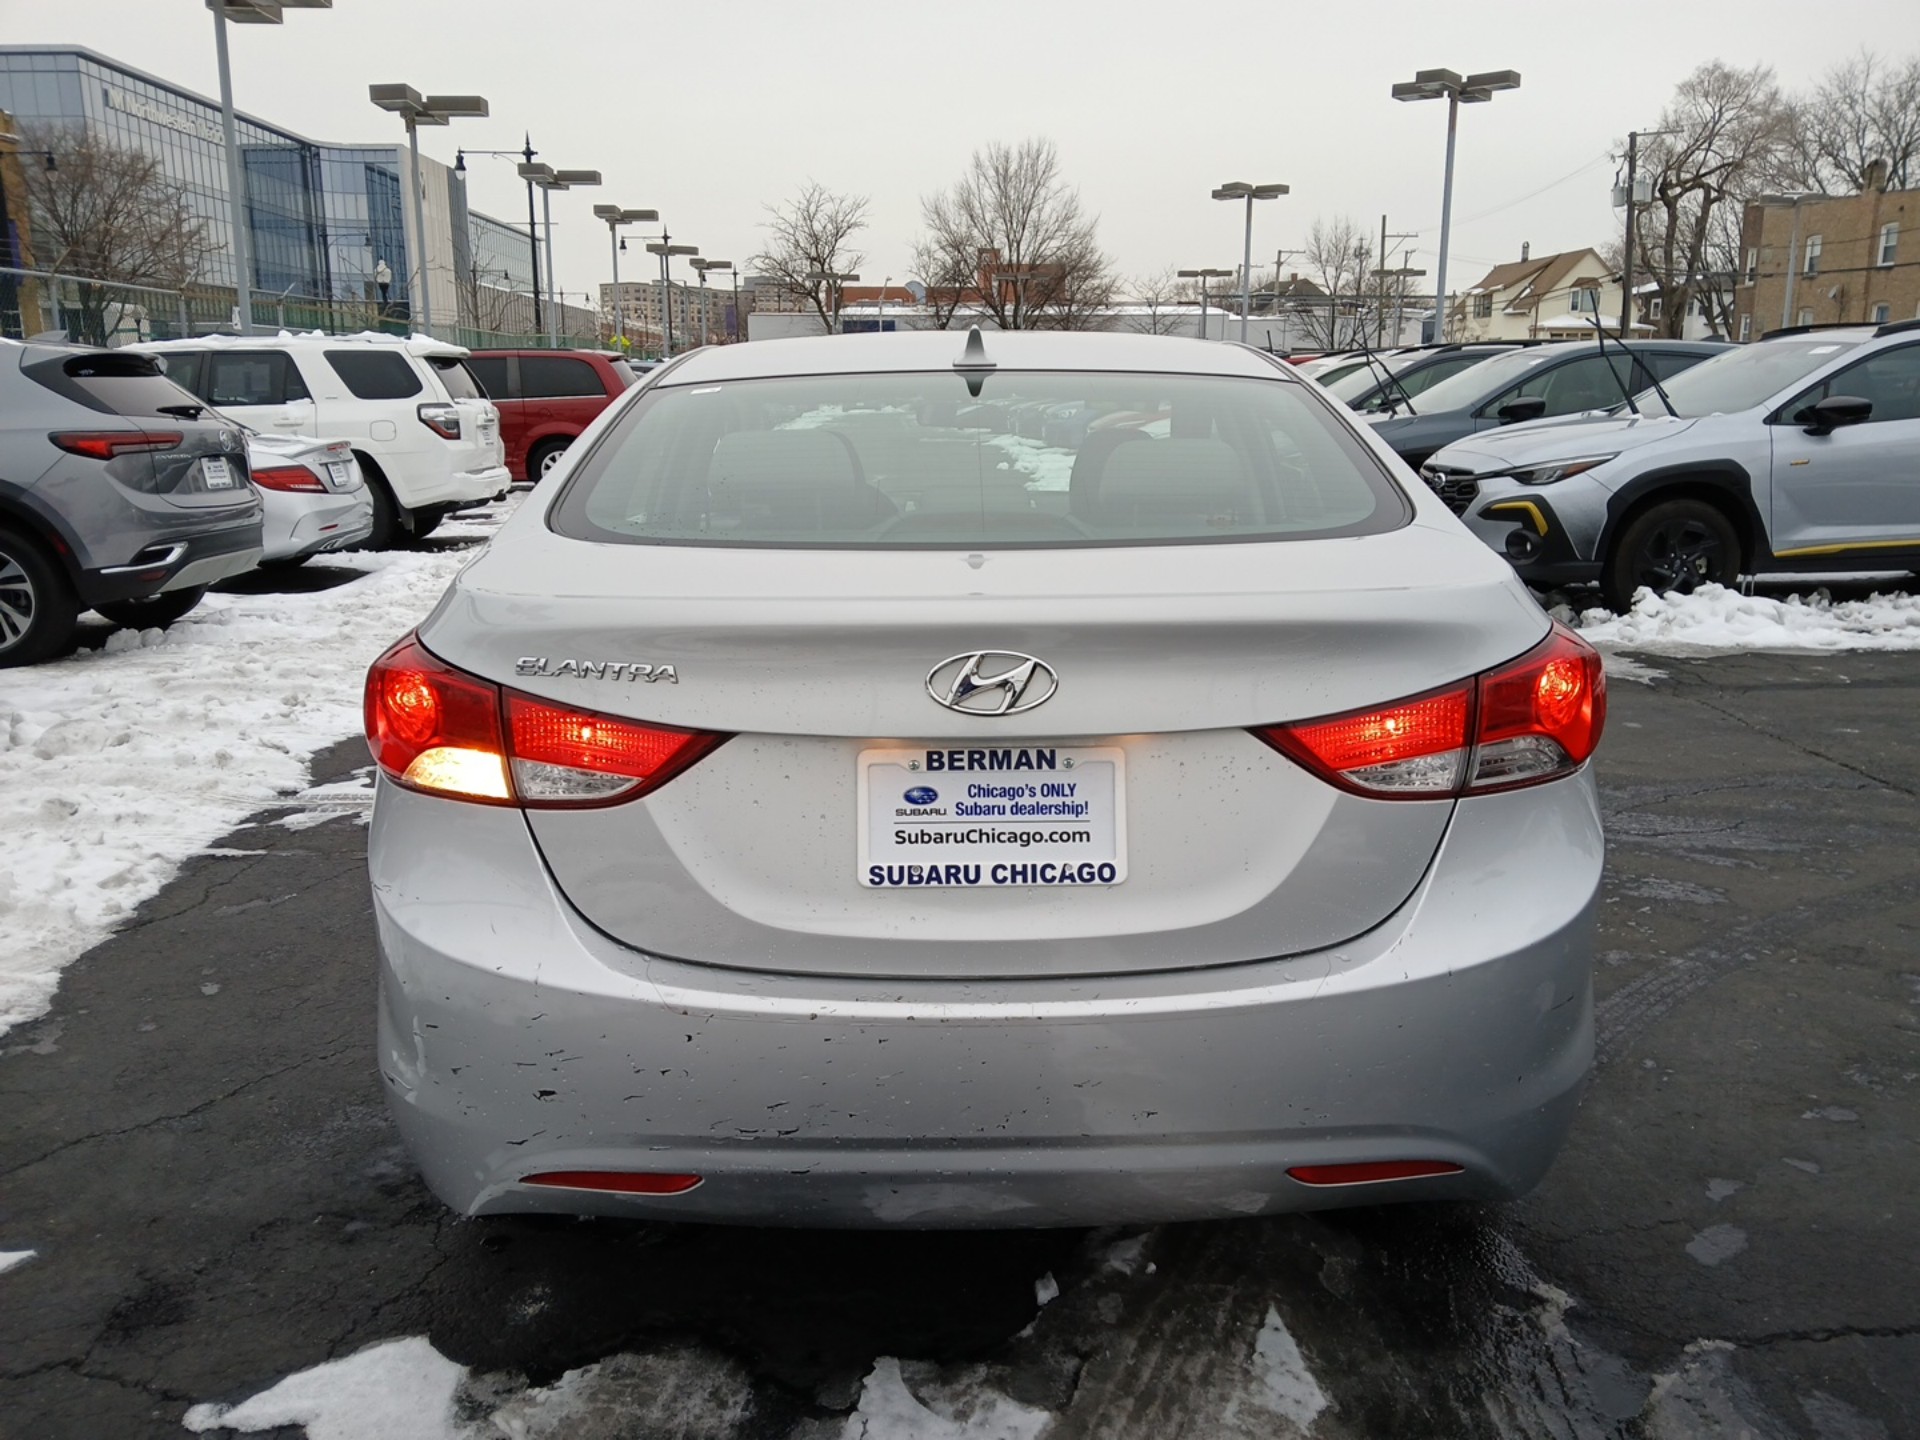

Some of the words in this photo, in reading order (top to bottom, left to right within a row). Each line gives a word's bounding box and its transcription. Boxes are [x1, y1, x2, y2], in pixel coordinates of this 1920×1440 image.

[126, 95, 197, 136] Northwestern
[515, 656, 679, 684] ELANTRA
[926, 749, 1056, 771] BERMAN
[967, 783, 1036, 800] Chicago's
[1040, 783, 1077, 798] ONLY
[895, 808, 947, 817] SUBARU
[955, 801, 1007, 816] Subaru
[1010, 800, 1089, 818] dealership!
[894, 828, 1091, 847] SubaruChicago.com
[868, 864, 981, 886] SUBARU
[990, 863, 1117, 884] CHICAGO
